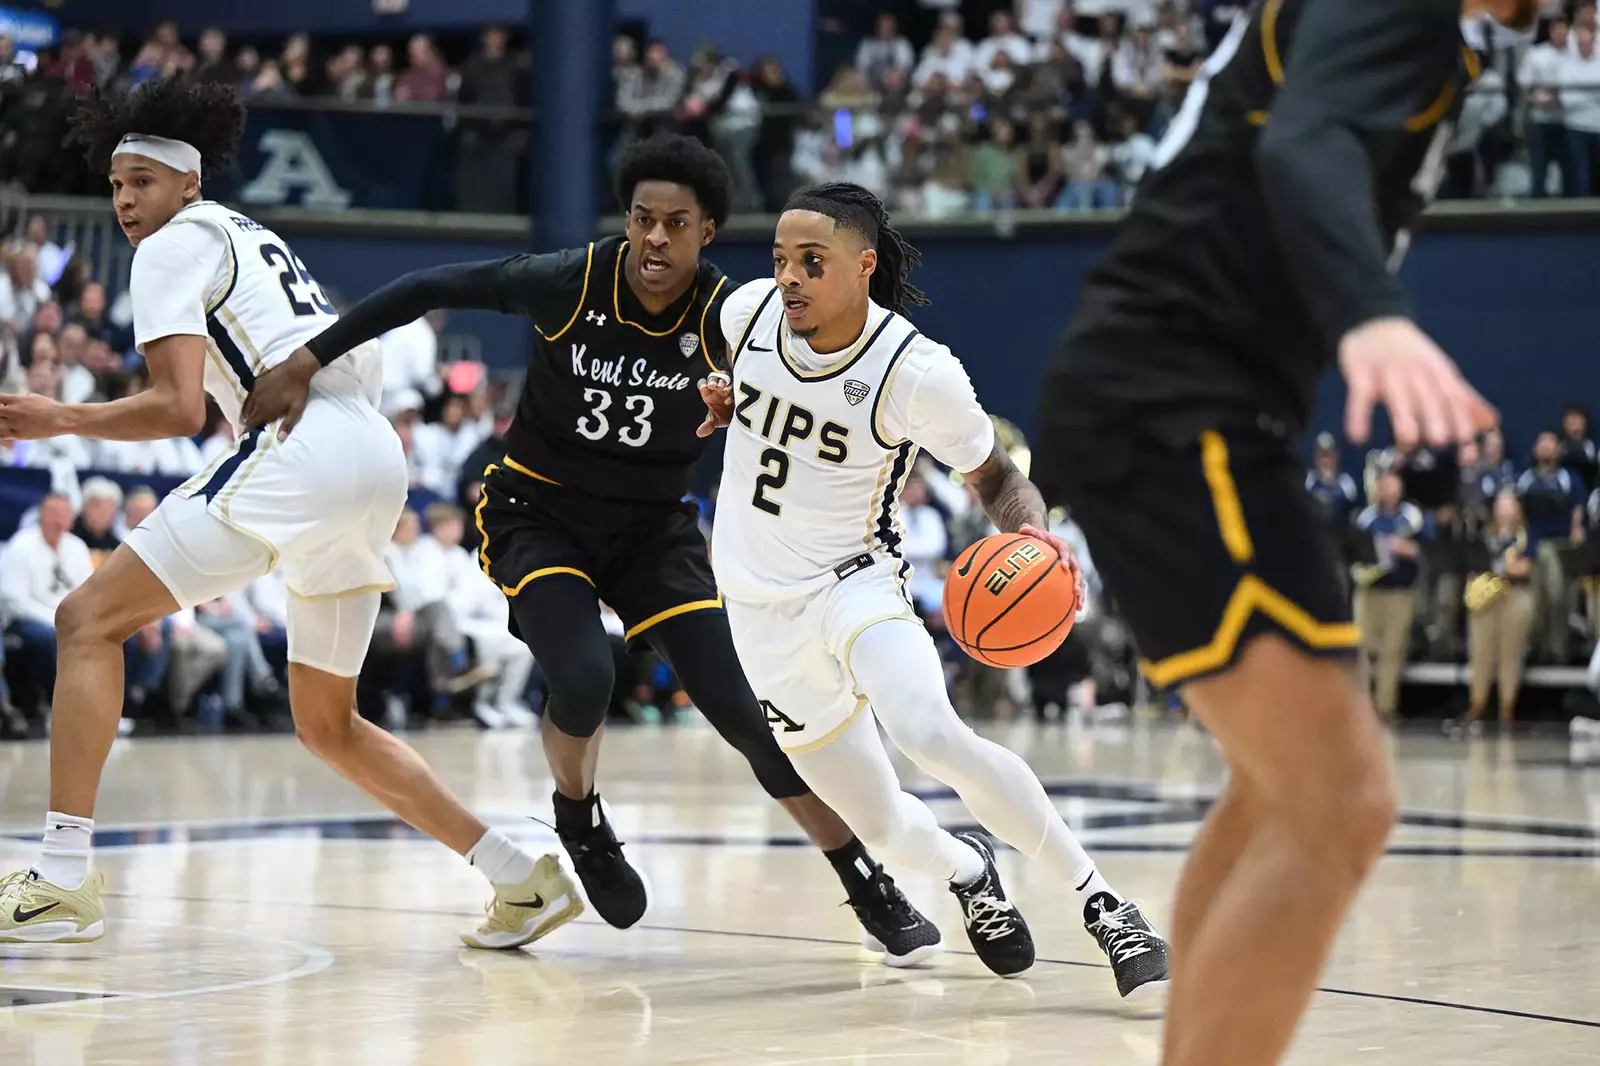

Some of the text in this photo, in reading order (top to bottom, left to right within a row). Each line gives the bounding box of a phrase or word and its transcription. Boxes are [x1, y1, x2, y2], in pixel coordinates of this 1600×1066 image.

[241, 128, 352, 208] A
[571, 343, 690, 390] Kent State
[845, 386, 868, 397] MAC
[575, 387, 655, 447] 33
[735, 380, 852, 465] ZIPS
[751, 446, 792, 518] 2
[984, 542, 1043, 597] ELITE
